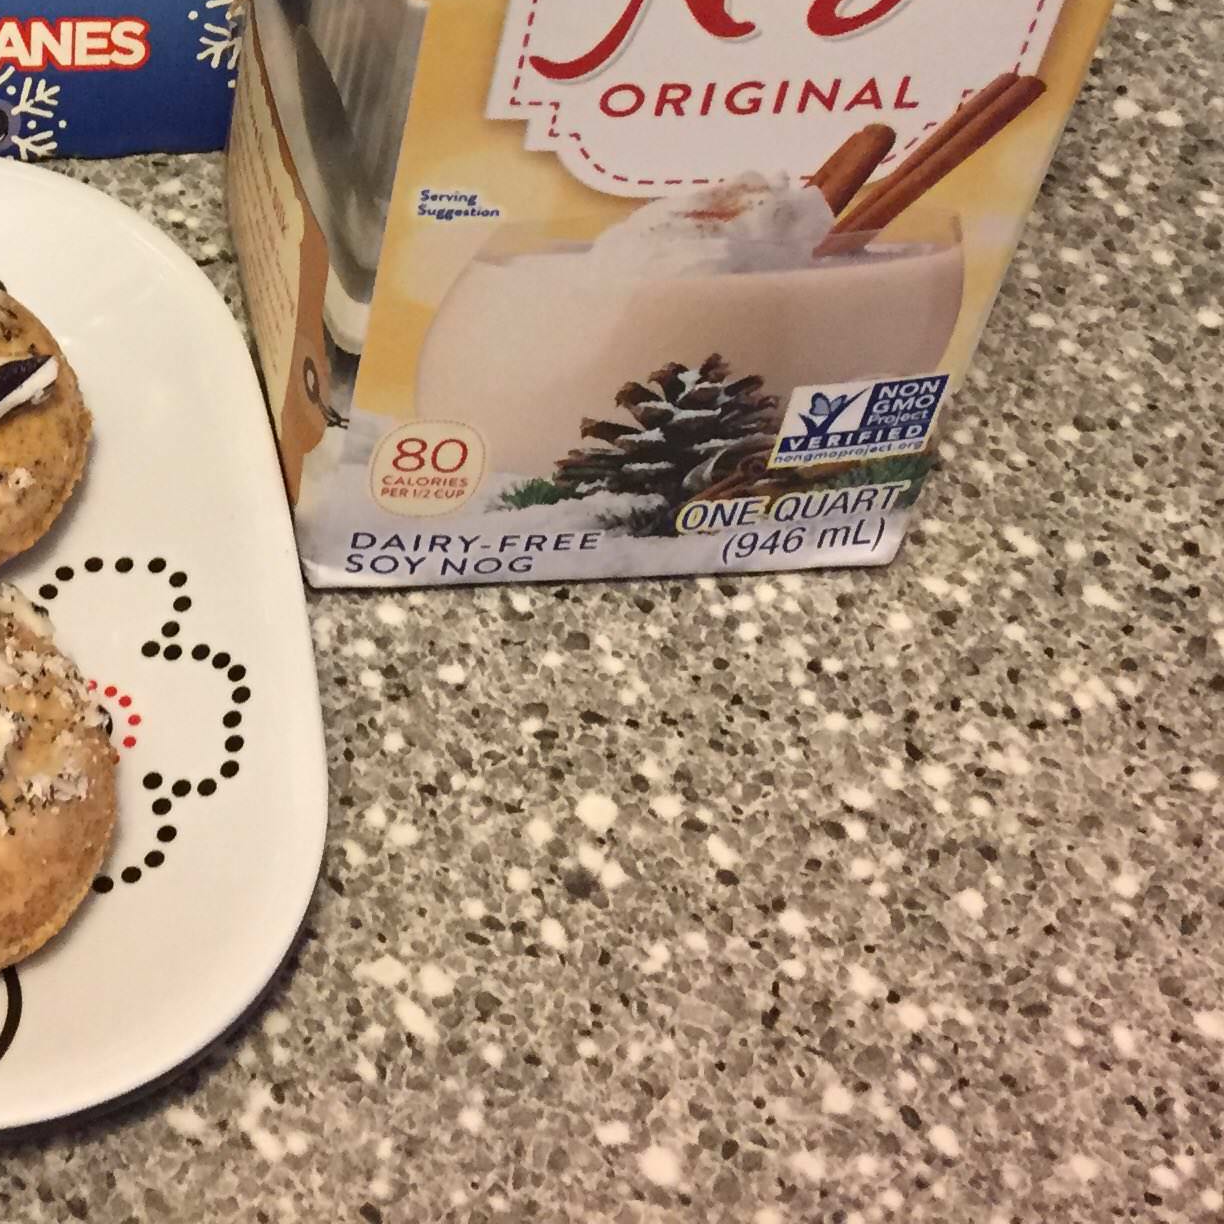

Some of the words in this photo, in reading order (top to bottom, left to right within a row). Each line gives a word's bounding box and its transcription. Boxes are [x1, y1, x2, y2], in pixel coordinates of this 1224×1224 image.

[599, 75, 919, 118] ORIGINAL
[420, 189, 477, 206] Serving
[417, 203, 500, 220] Suggestion
[878, 379, 941, 399] NON
[872, 394, 936, 414] GMO
[866, 410, 928, 426] Project
[789, 425, 923, 450] VERIFIED
[392, 438, 468, 473] 80
[774, 440, 923, 463] nongmoproject.org
[381, 475, 468, 487] CALORIES
[381, 487, 409, 497] PER
[413, 488, 430, 498] 1/2
[434, 488, 465, 499] CUP
[681, 499, 763, 531] ONE
[774, 485, 904, 523] QUART
[350, 532, 602, 553] DAIRY-FREE
[722, 526, 806, 564] (946
[817, 517, 885, 552] mL)
[345, 553, 426, 575] SOY
[440, 556, 534, 576] NOG
